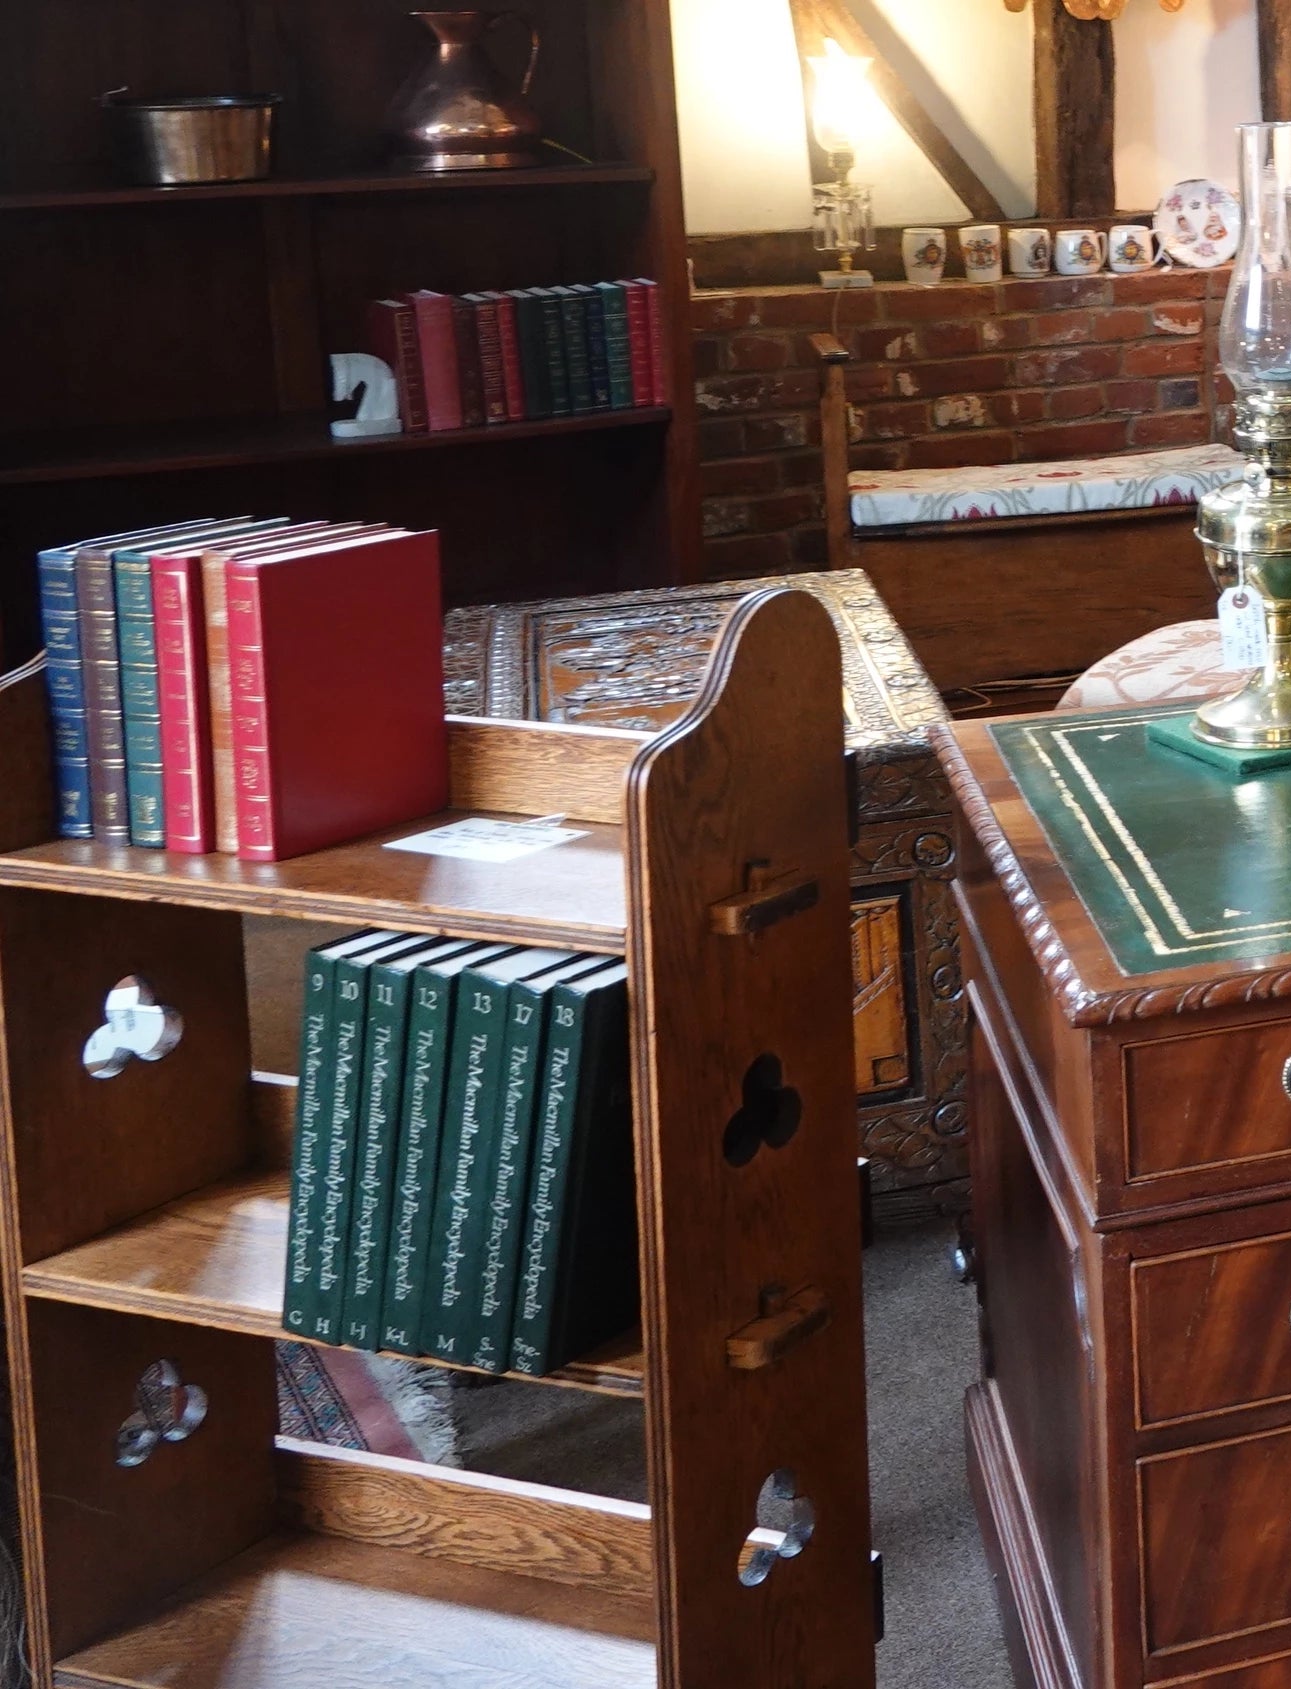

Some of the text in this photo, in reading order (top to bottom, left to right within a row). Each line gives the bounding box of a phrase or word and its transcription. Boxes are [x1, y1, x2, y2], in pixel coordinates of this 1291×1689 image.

[312, 974, 324, 992] 9
[340, 980, 359, 1000] 10
[376, 984, 394, 1006] 11
[419, 987, 438, 1010] 12
[472, 992, 492, 1014] 13
[515, 1004, 534, 1025] 17
[555, 1005, 575, 1027] 18
[292, 1014, 324, 1283] The Macmillan Family Encyclopedia
[319, 1021, 356, 1291] The Macmillan Family Encyclopedia
[354, 1026, 391, 1296] The Macmillan Family Encyclopedia
[394, 1029, 434, 1300] The Macmillan Family Encyclopedia
[441, 1034, 488, 1306] The Macmillan Family Encyclopedia
[481, 1046, 529, 1317] The Macmillan Family Encyclopedia
[523, 1047, 570, 1320] The Macmillan Family Encyclopedia
[289, 1310, 303, 1325] G
[316, 1317, 330, 1334] H
[436, 1334, 456, 1351] M
